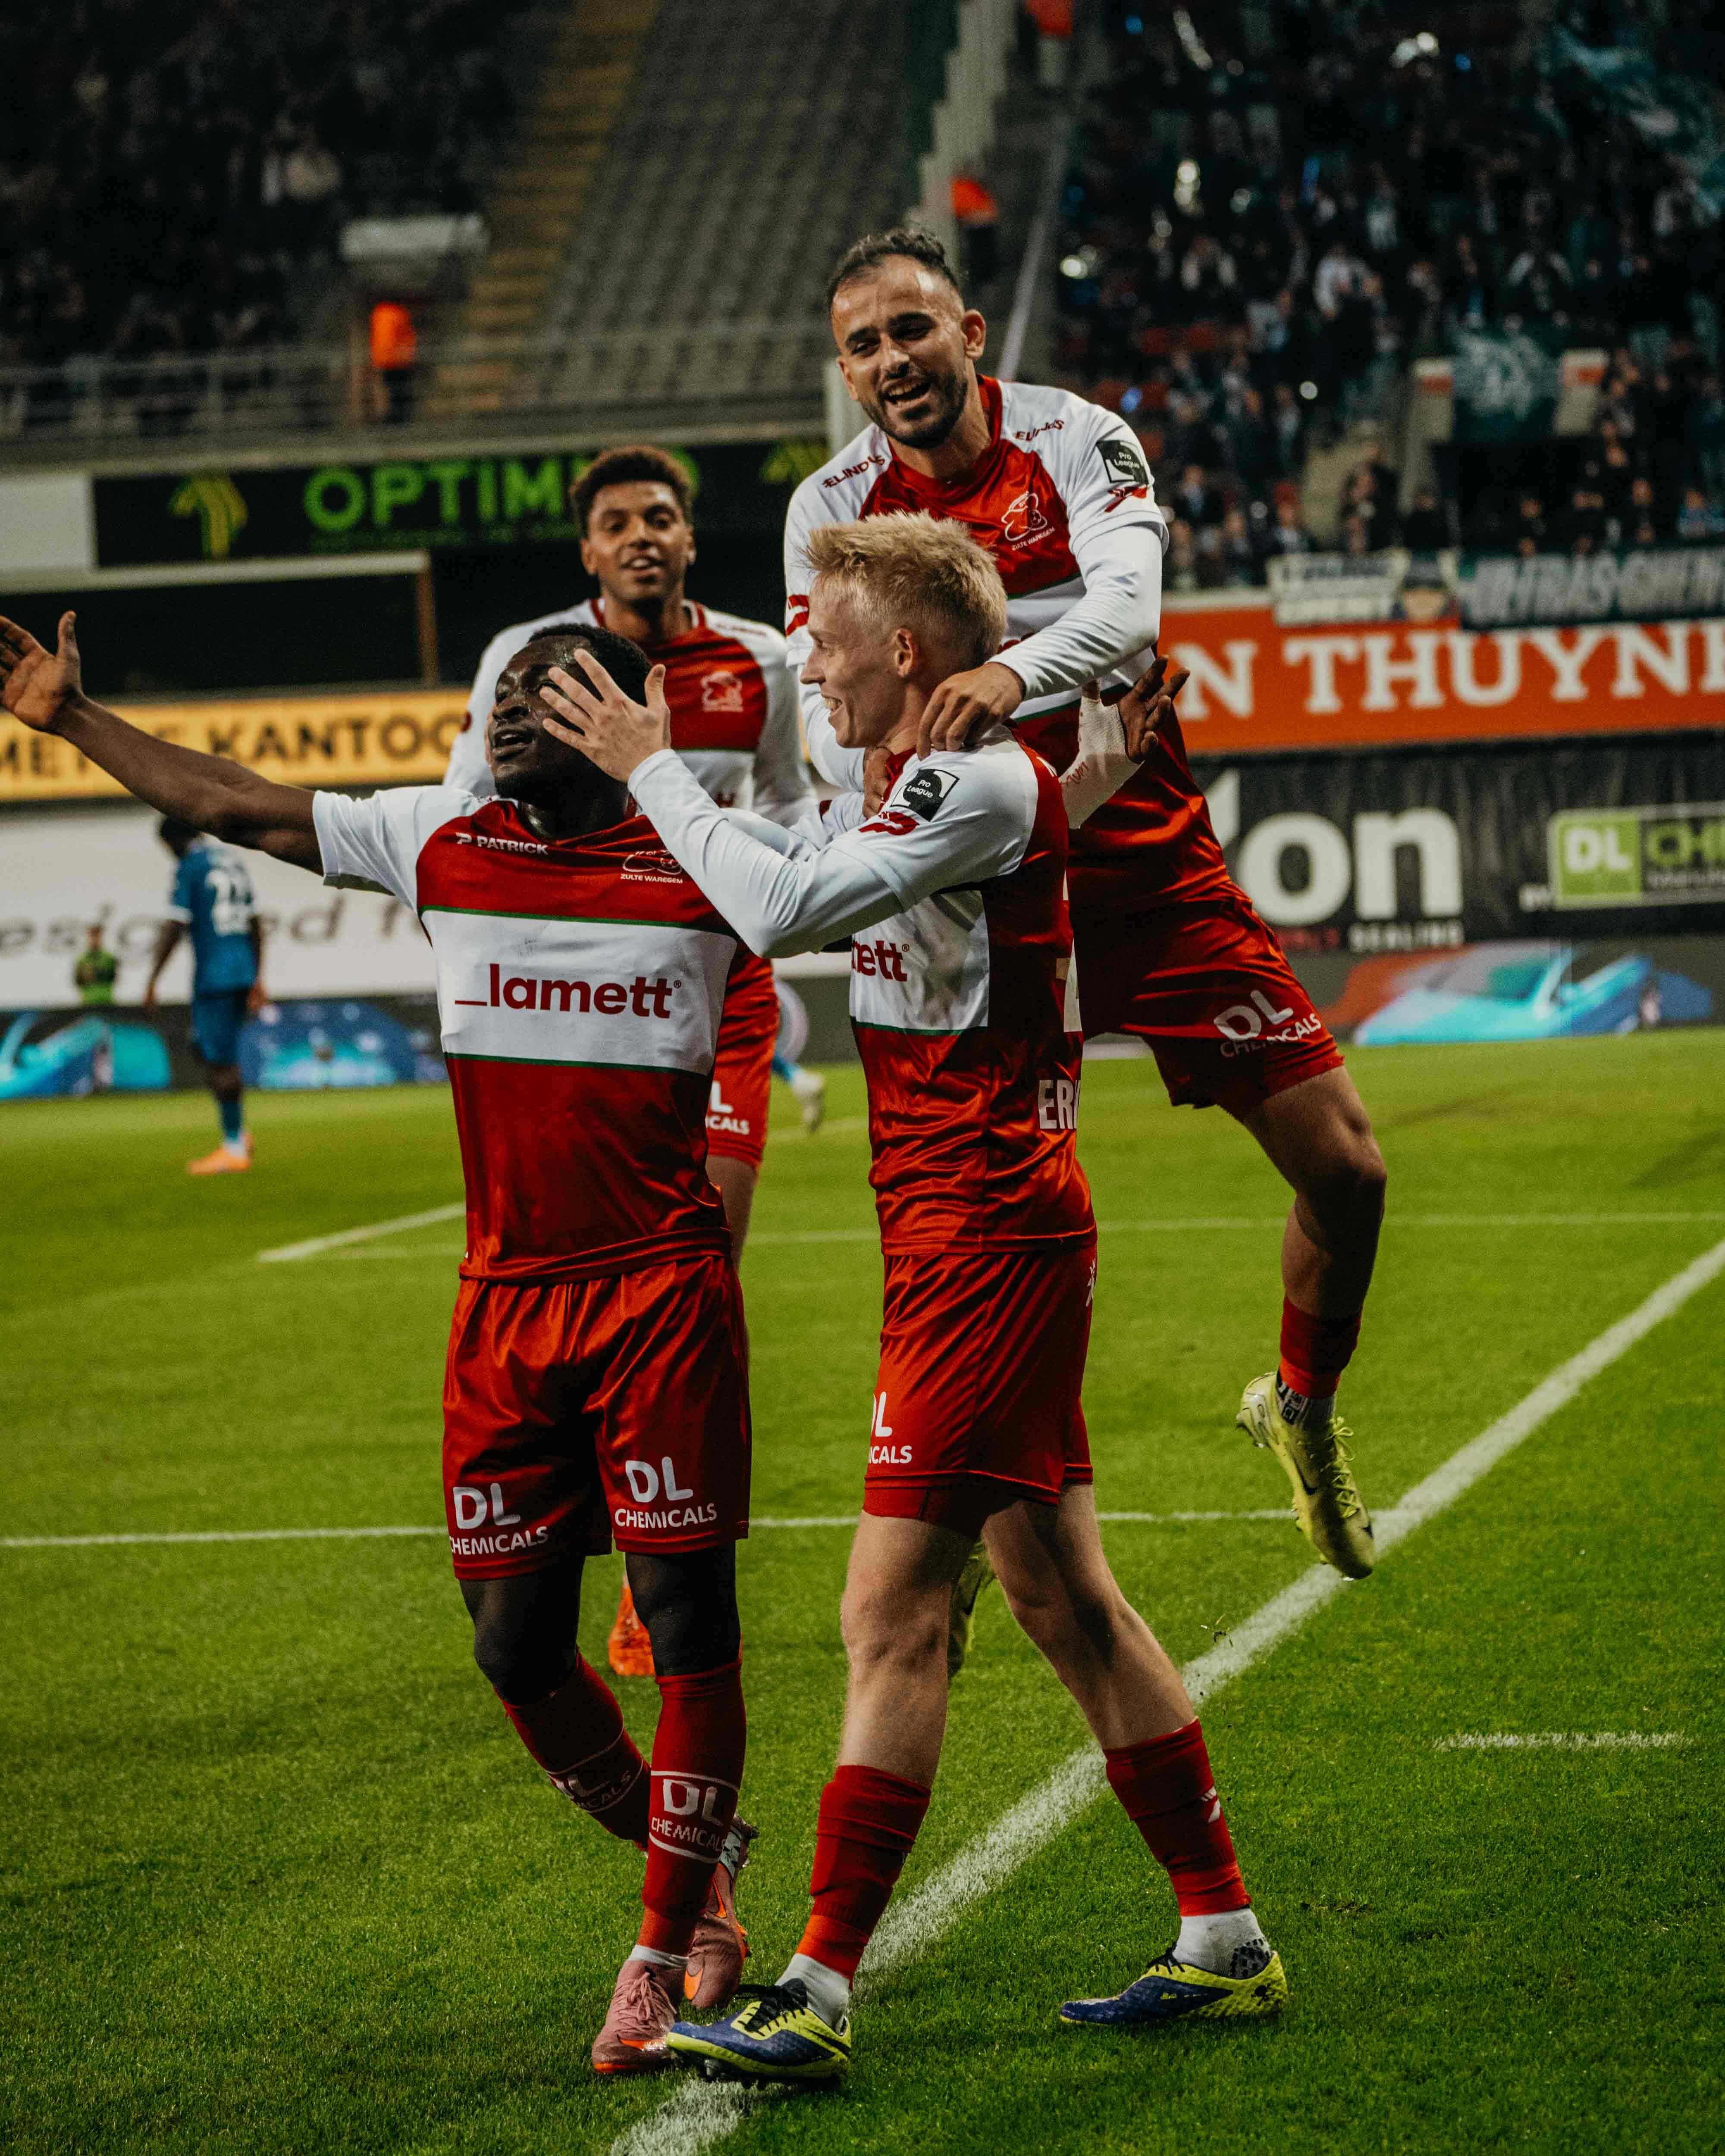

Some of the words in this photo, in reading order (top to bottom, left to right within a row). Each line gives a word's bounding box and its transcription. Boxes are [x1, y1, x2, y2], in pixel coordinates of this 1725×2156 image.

[906, 785, 934, 798] League
[918, 779, 931, 788] Pro
[477, 835, 549, 856] PATRICK
[1565, 826, 1634, 872] DL
[644, 875, 684, 884] WAREGEM
[1214, 990, 1293, 1040] DL
[624, 1456, 693, 1503] DL
[452, 1482, 521, 1529] DL
[614, 1503, 718, 1529] CHEMICALS
[663, 1778, 725, 1827] DL
